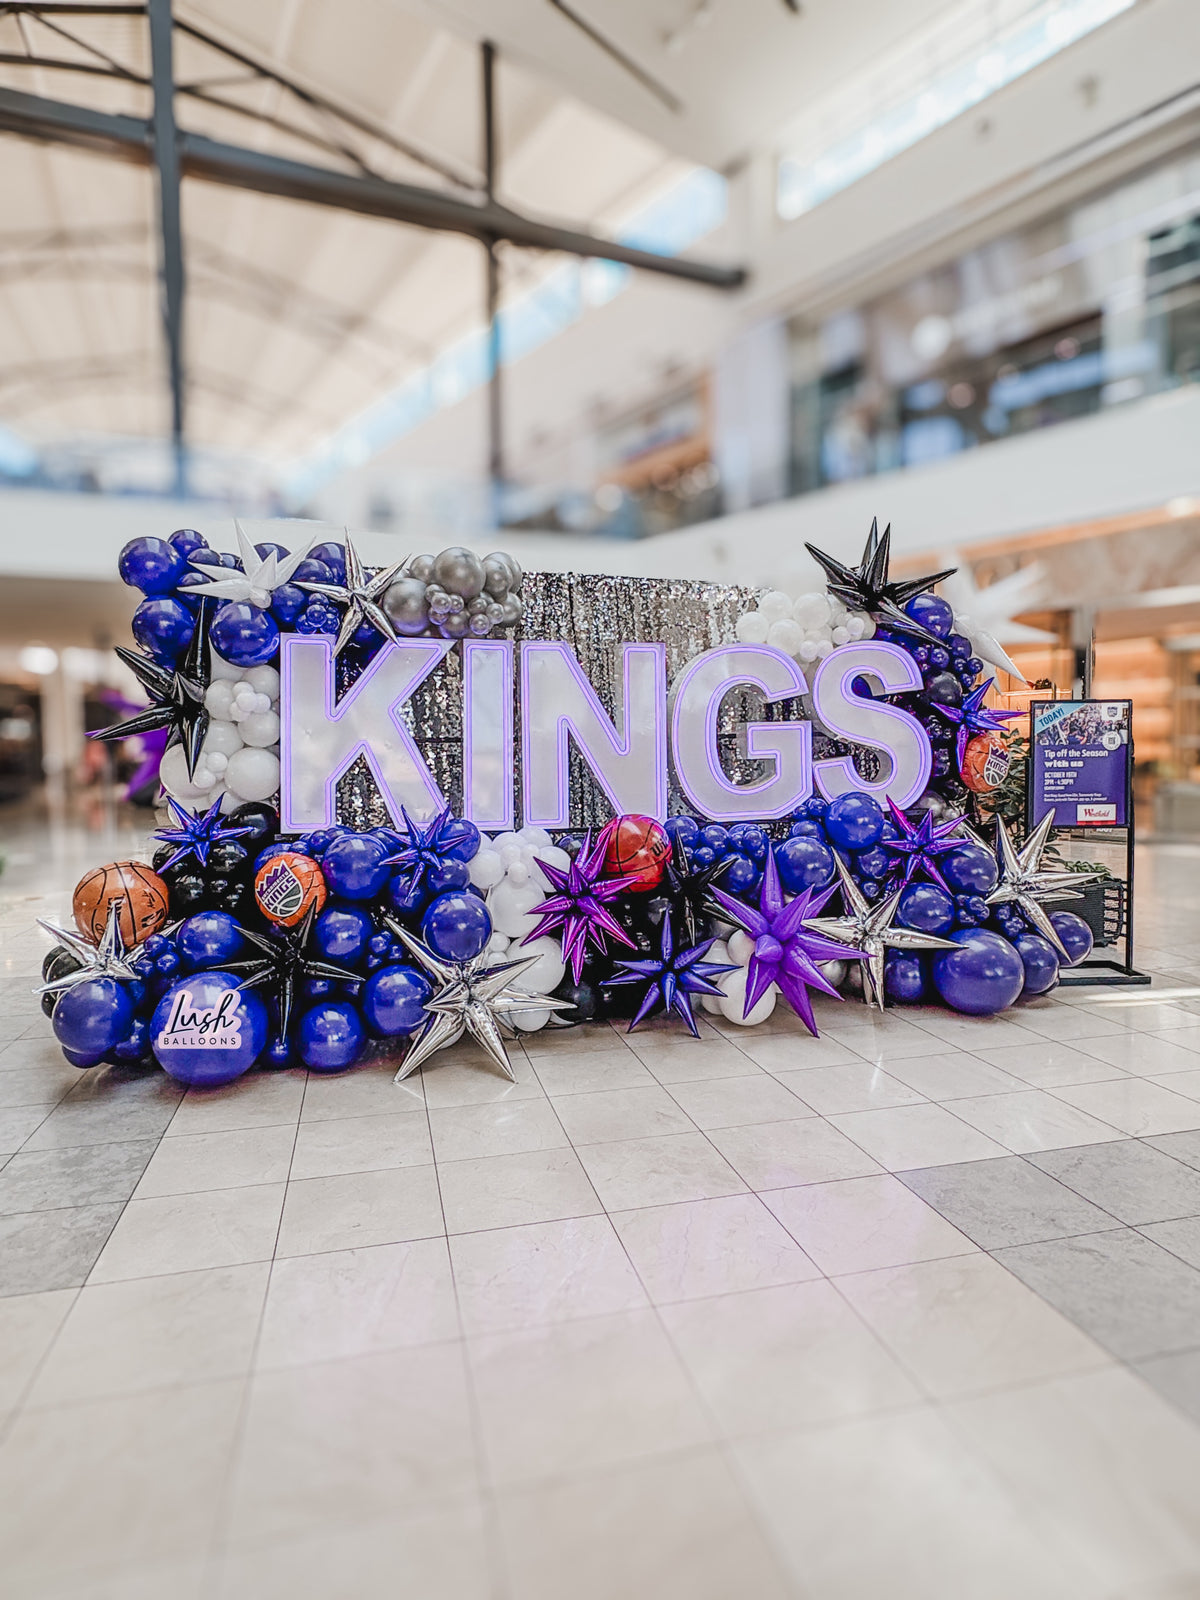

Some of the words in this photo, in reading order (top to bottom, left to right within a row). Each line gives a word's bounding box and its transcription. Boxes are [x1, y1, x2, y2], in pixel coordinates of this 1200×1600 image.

[1039, 707, 1065, 727] TODAY!
[280, 632, 932, 834] KINGS
[1044, 750, 1055, 759] Tip
[1056, 749, 1068, 757] off
[1069, 749, 1080, 757] the
[1081, 749, 1108, 757] Season
[986, 758, 1008, 776] KINGS
[1044, 760, 1069, 768] with
[264, 874, 297, 910] KINGS
